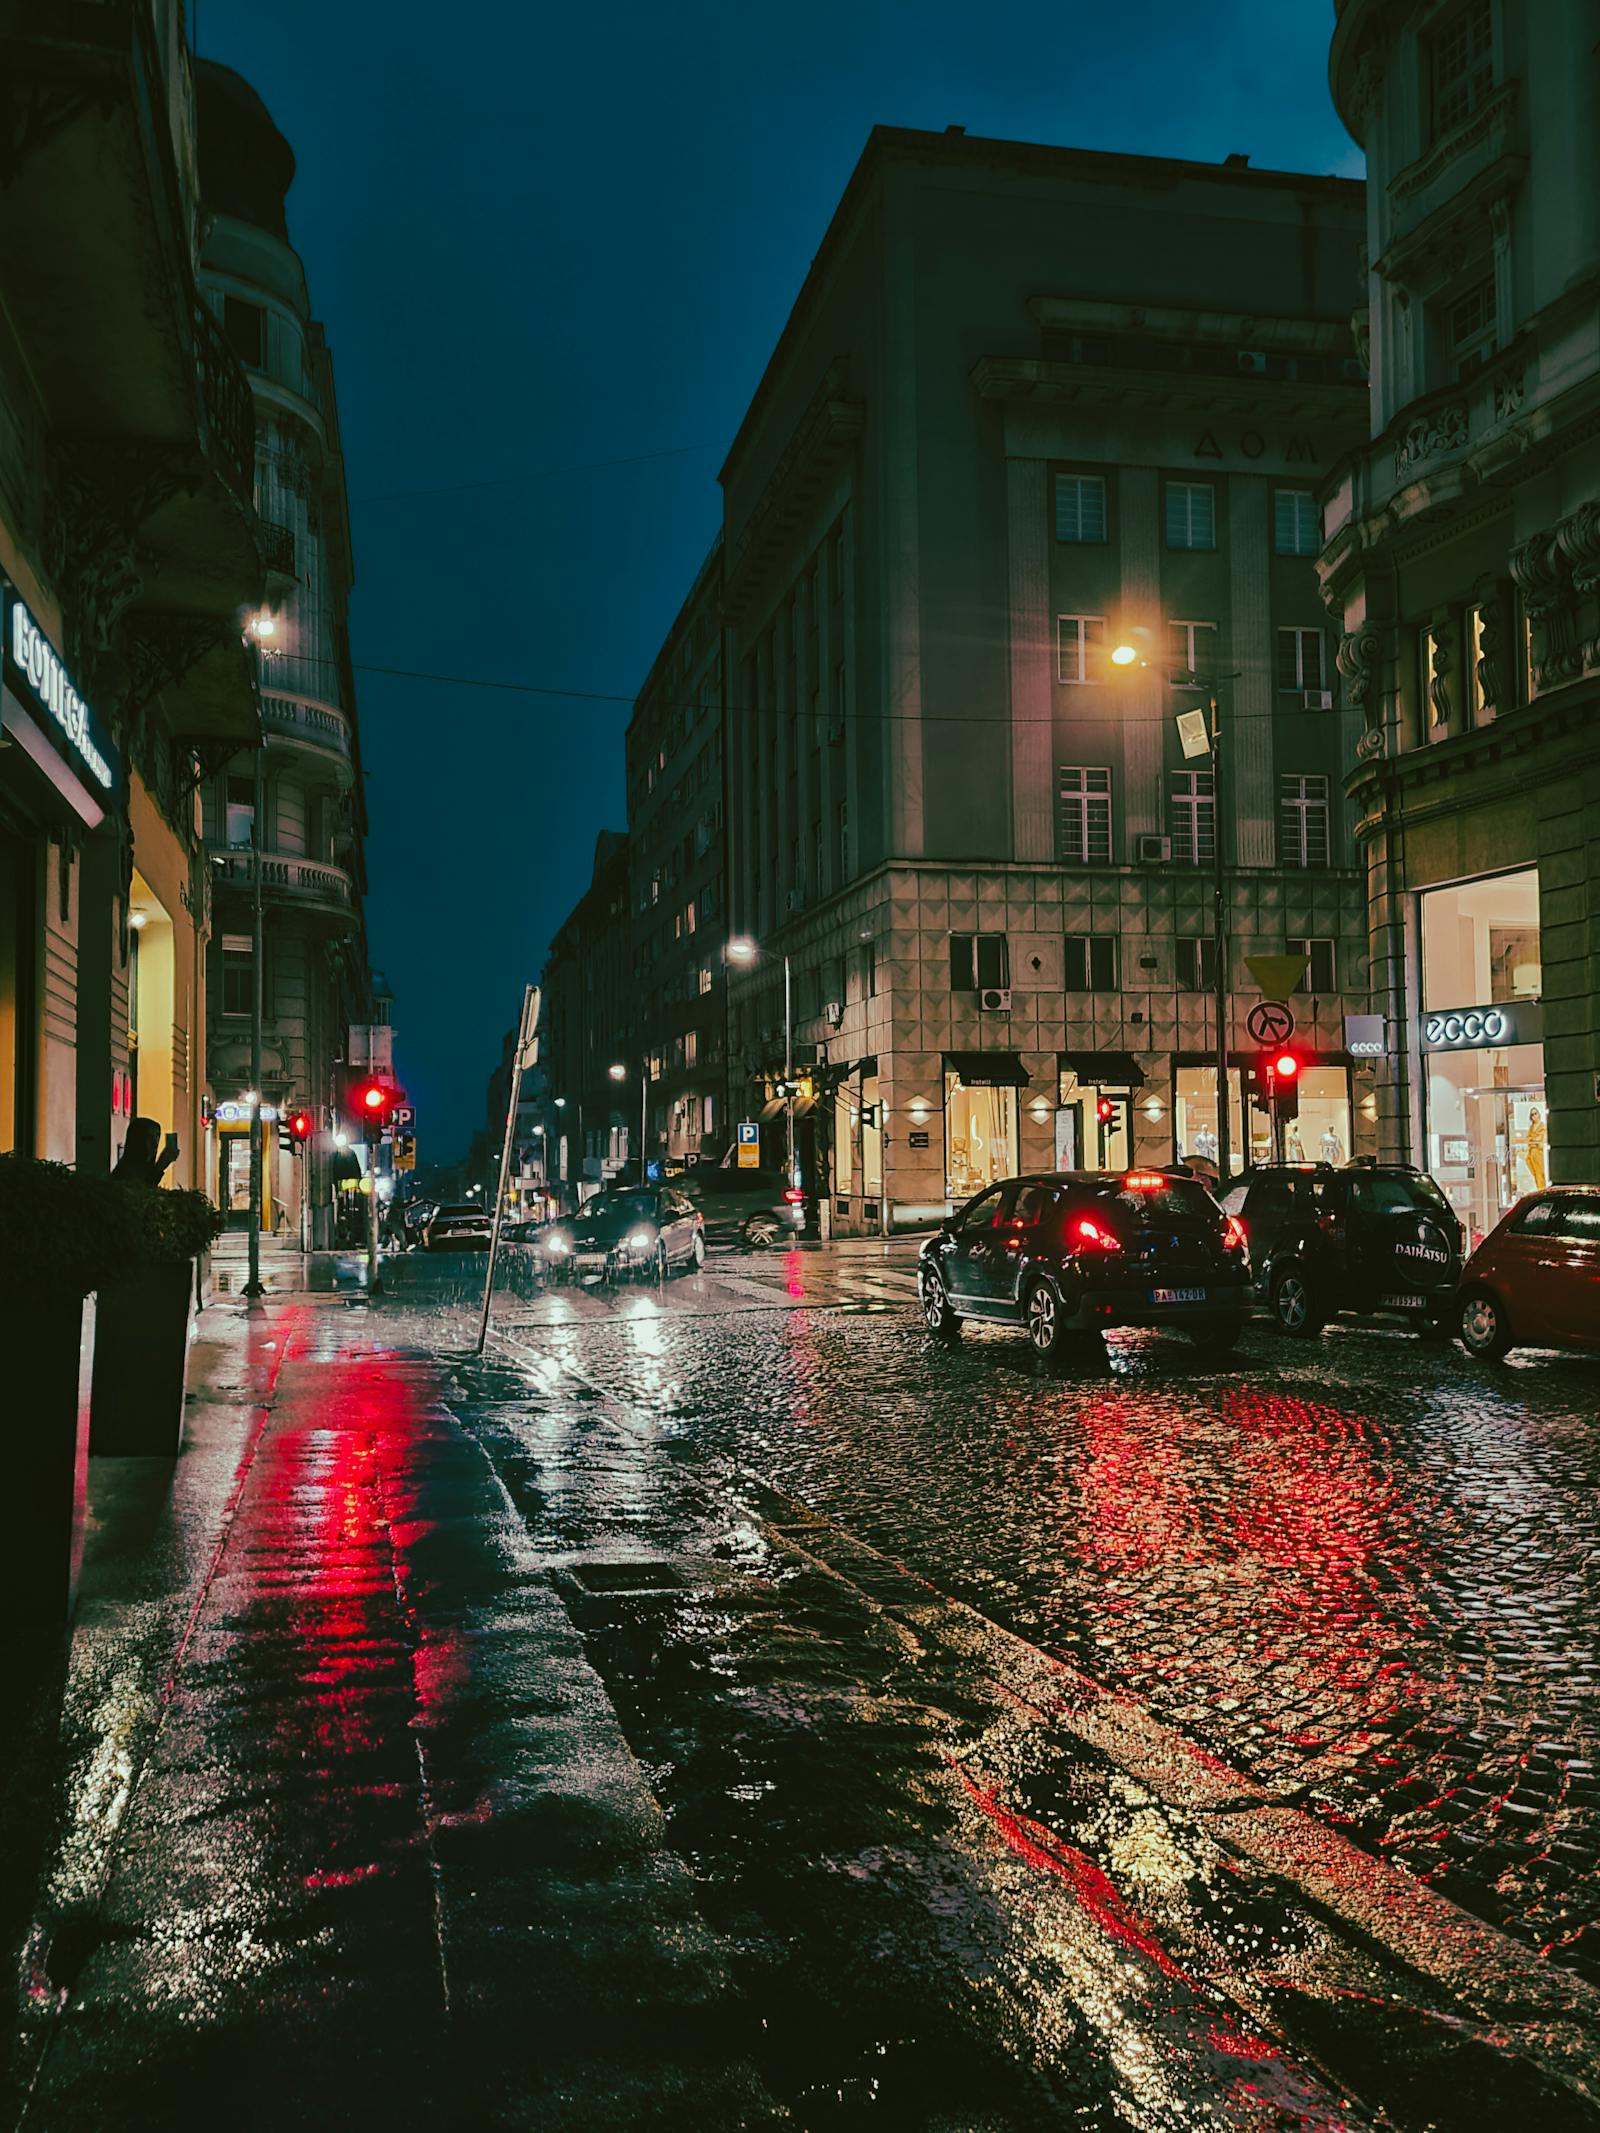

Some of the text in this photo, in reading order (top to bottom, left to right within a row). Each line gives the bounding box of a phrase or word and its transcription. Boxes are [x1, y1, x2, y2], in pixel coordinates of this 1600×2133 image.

[1425, 1011, 1505, 1045] ecco
[1350, 1042, 1382, 1053] ecco
[398, 1108, 411, 1126] P
[742, 1126, 755, 1142] P
[687, 1154, 698, 1168] P
[1394, 1244, 1448, 1264] DAIHATSU
